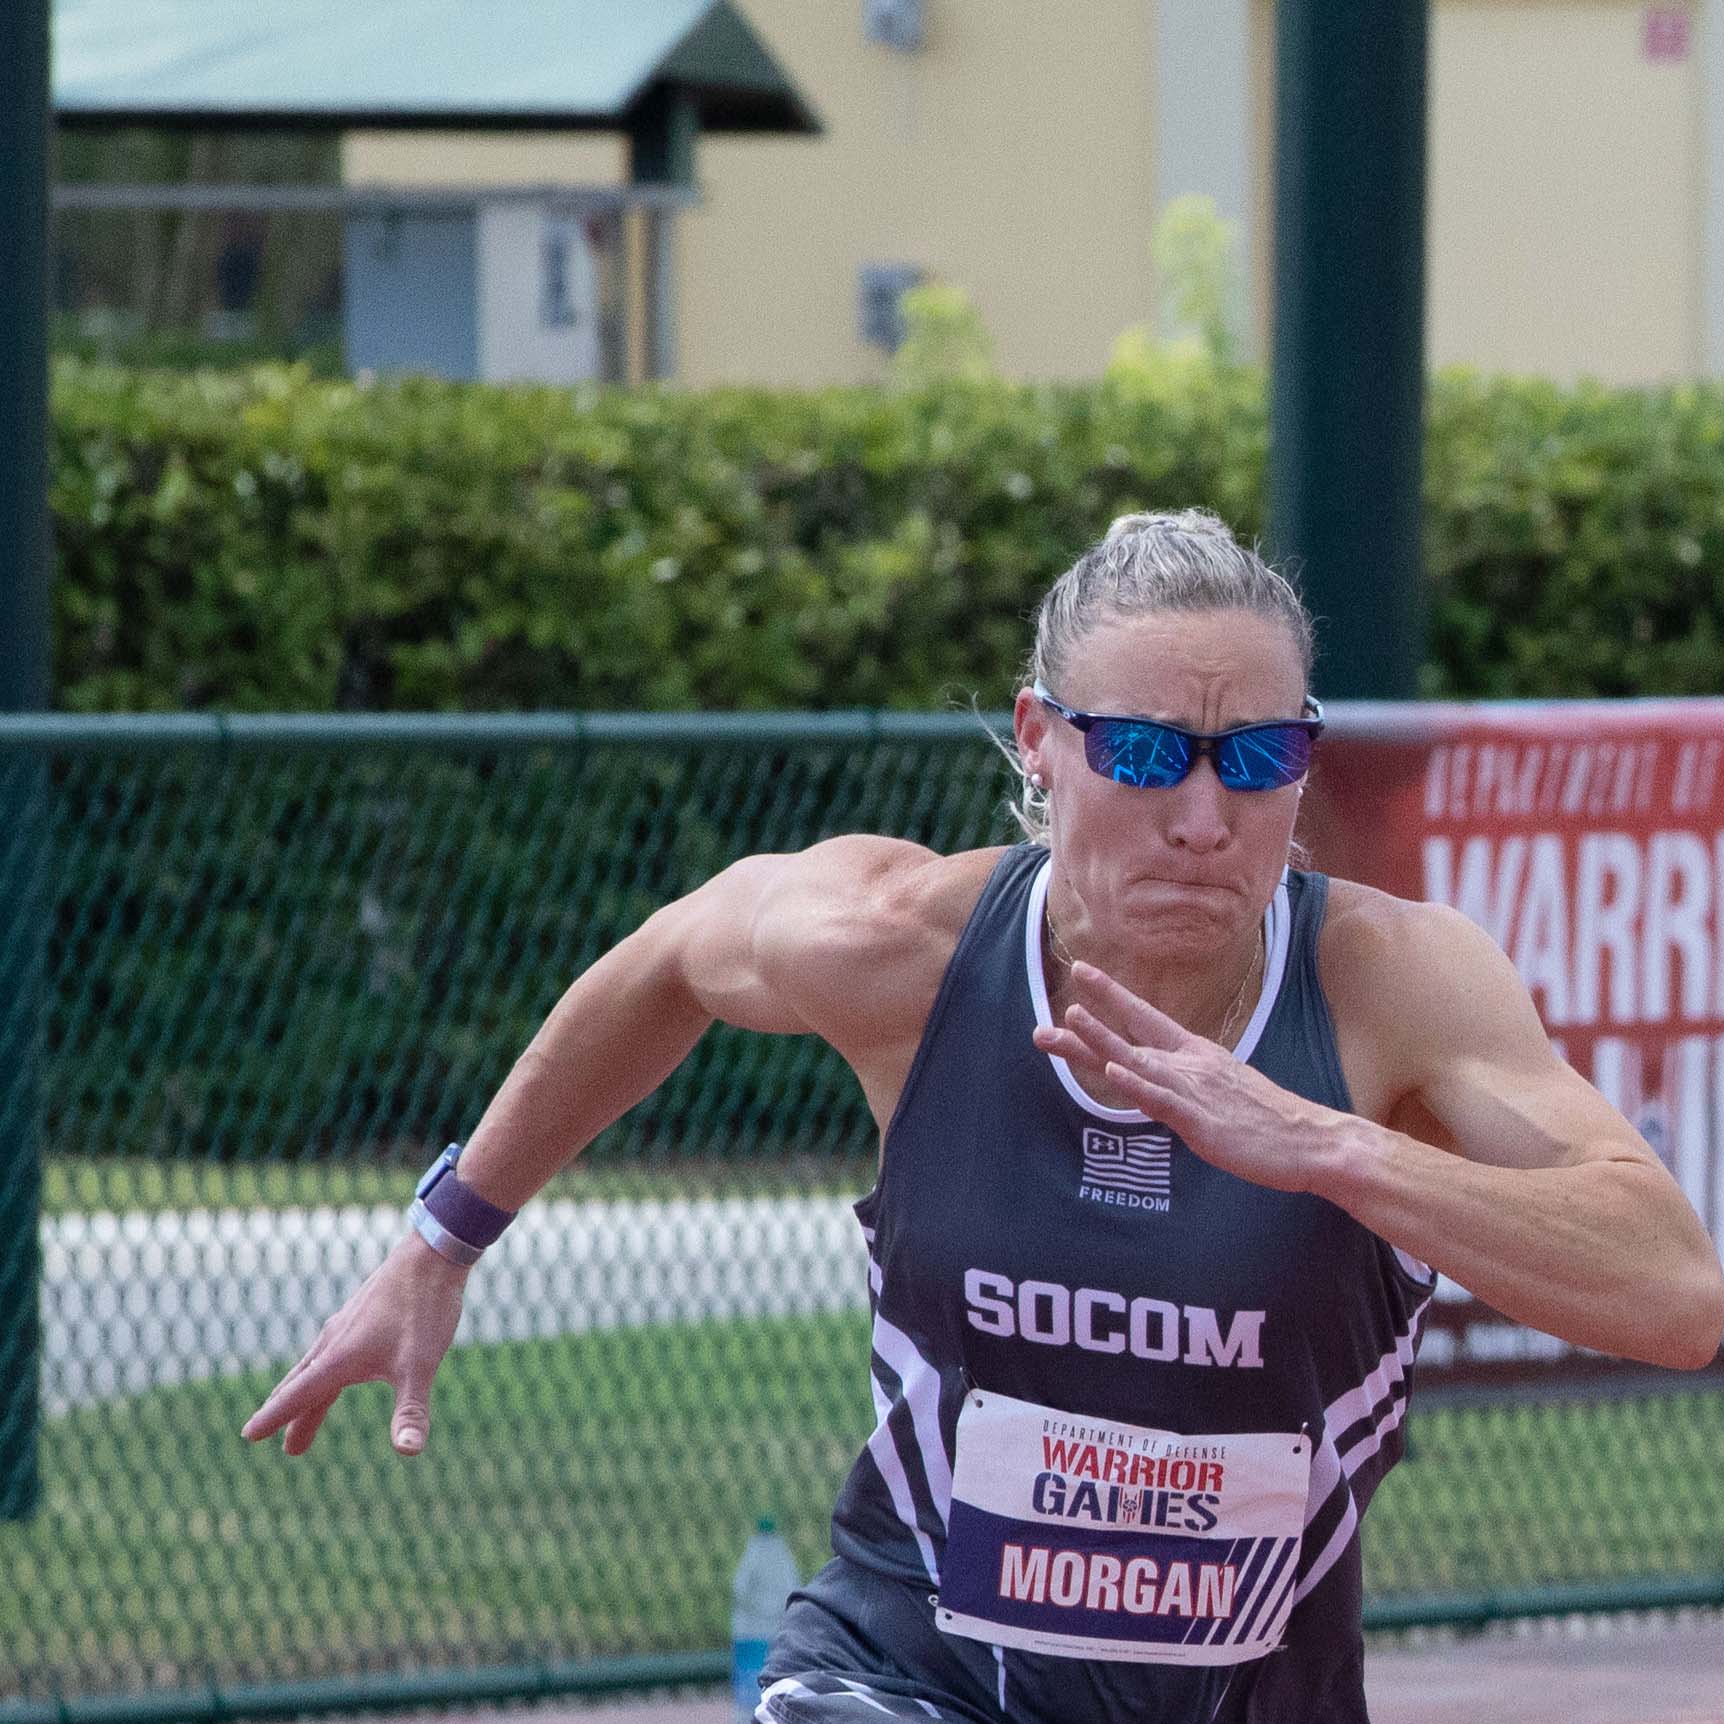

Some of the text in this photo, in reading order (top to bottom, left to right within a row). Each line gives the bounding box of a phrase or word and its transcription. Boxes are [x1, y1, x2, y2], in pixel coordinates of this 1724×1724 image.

[1078, 1184, 1171, 1212] FREEDOM
[963, 1267, 1267, 1369] SOCOM
[1042, 1419, 1227, 1460] DEPARTMENT OF DEFENSE
[1042, 1434, 1225, 1492] WARRIOR
[1032, 1471, 1221, 1532] GAMES
[998, 1543, 1239, 1619] MORGAN
